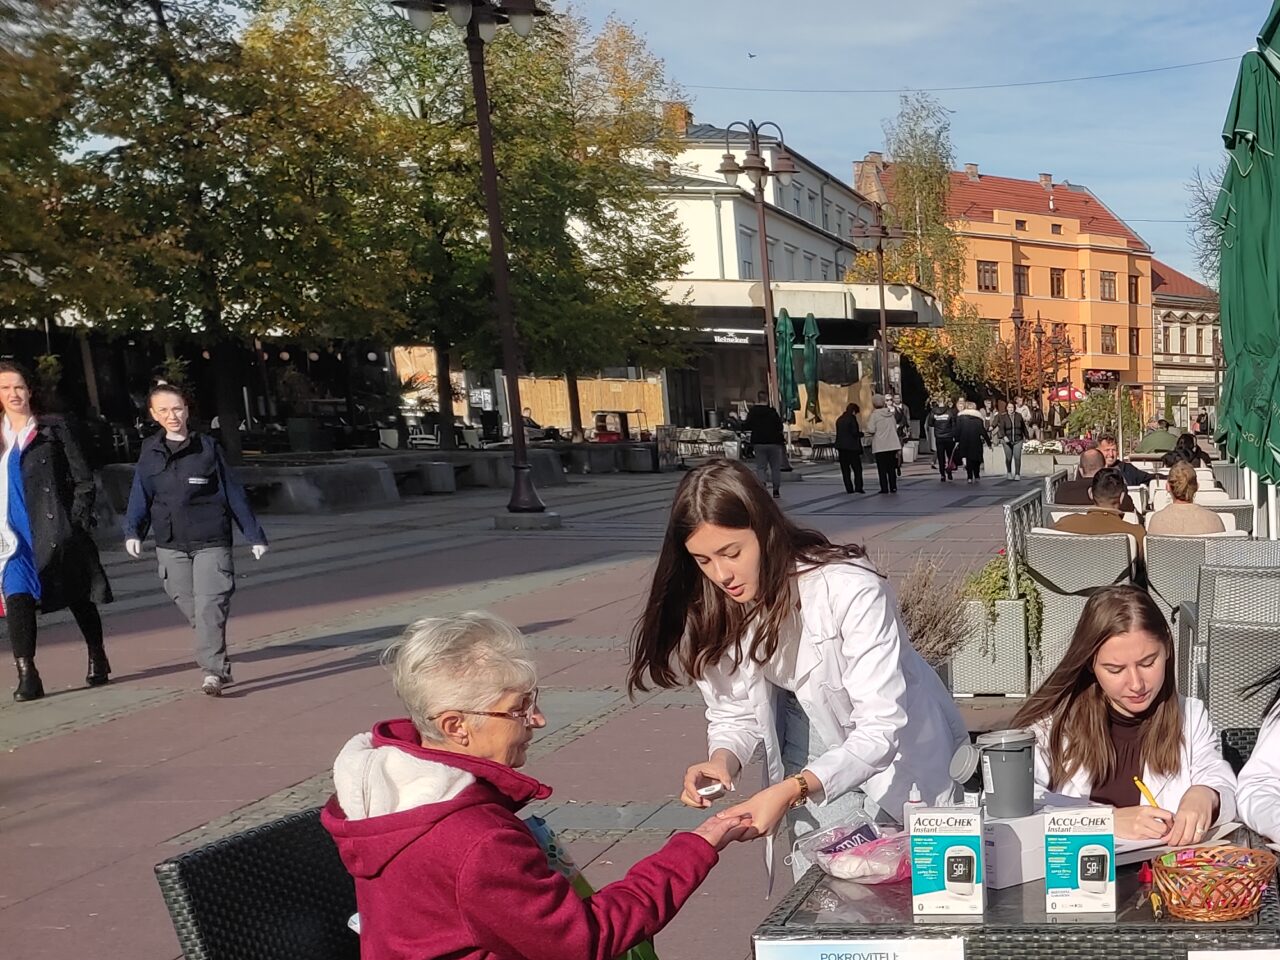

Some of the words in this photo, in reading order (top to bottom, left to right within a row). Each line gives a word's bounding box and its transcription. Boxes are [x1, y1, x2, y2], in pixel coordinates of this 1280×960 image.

[713, 336, 749, 344] Heineken
[914, 817, 972, 827] ACCU-CHEK
[1048, 816, 1107, 826] ACCU-CHEK
